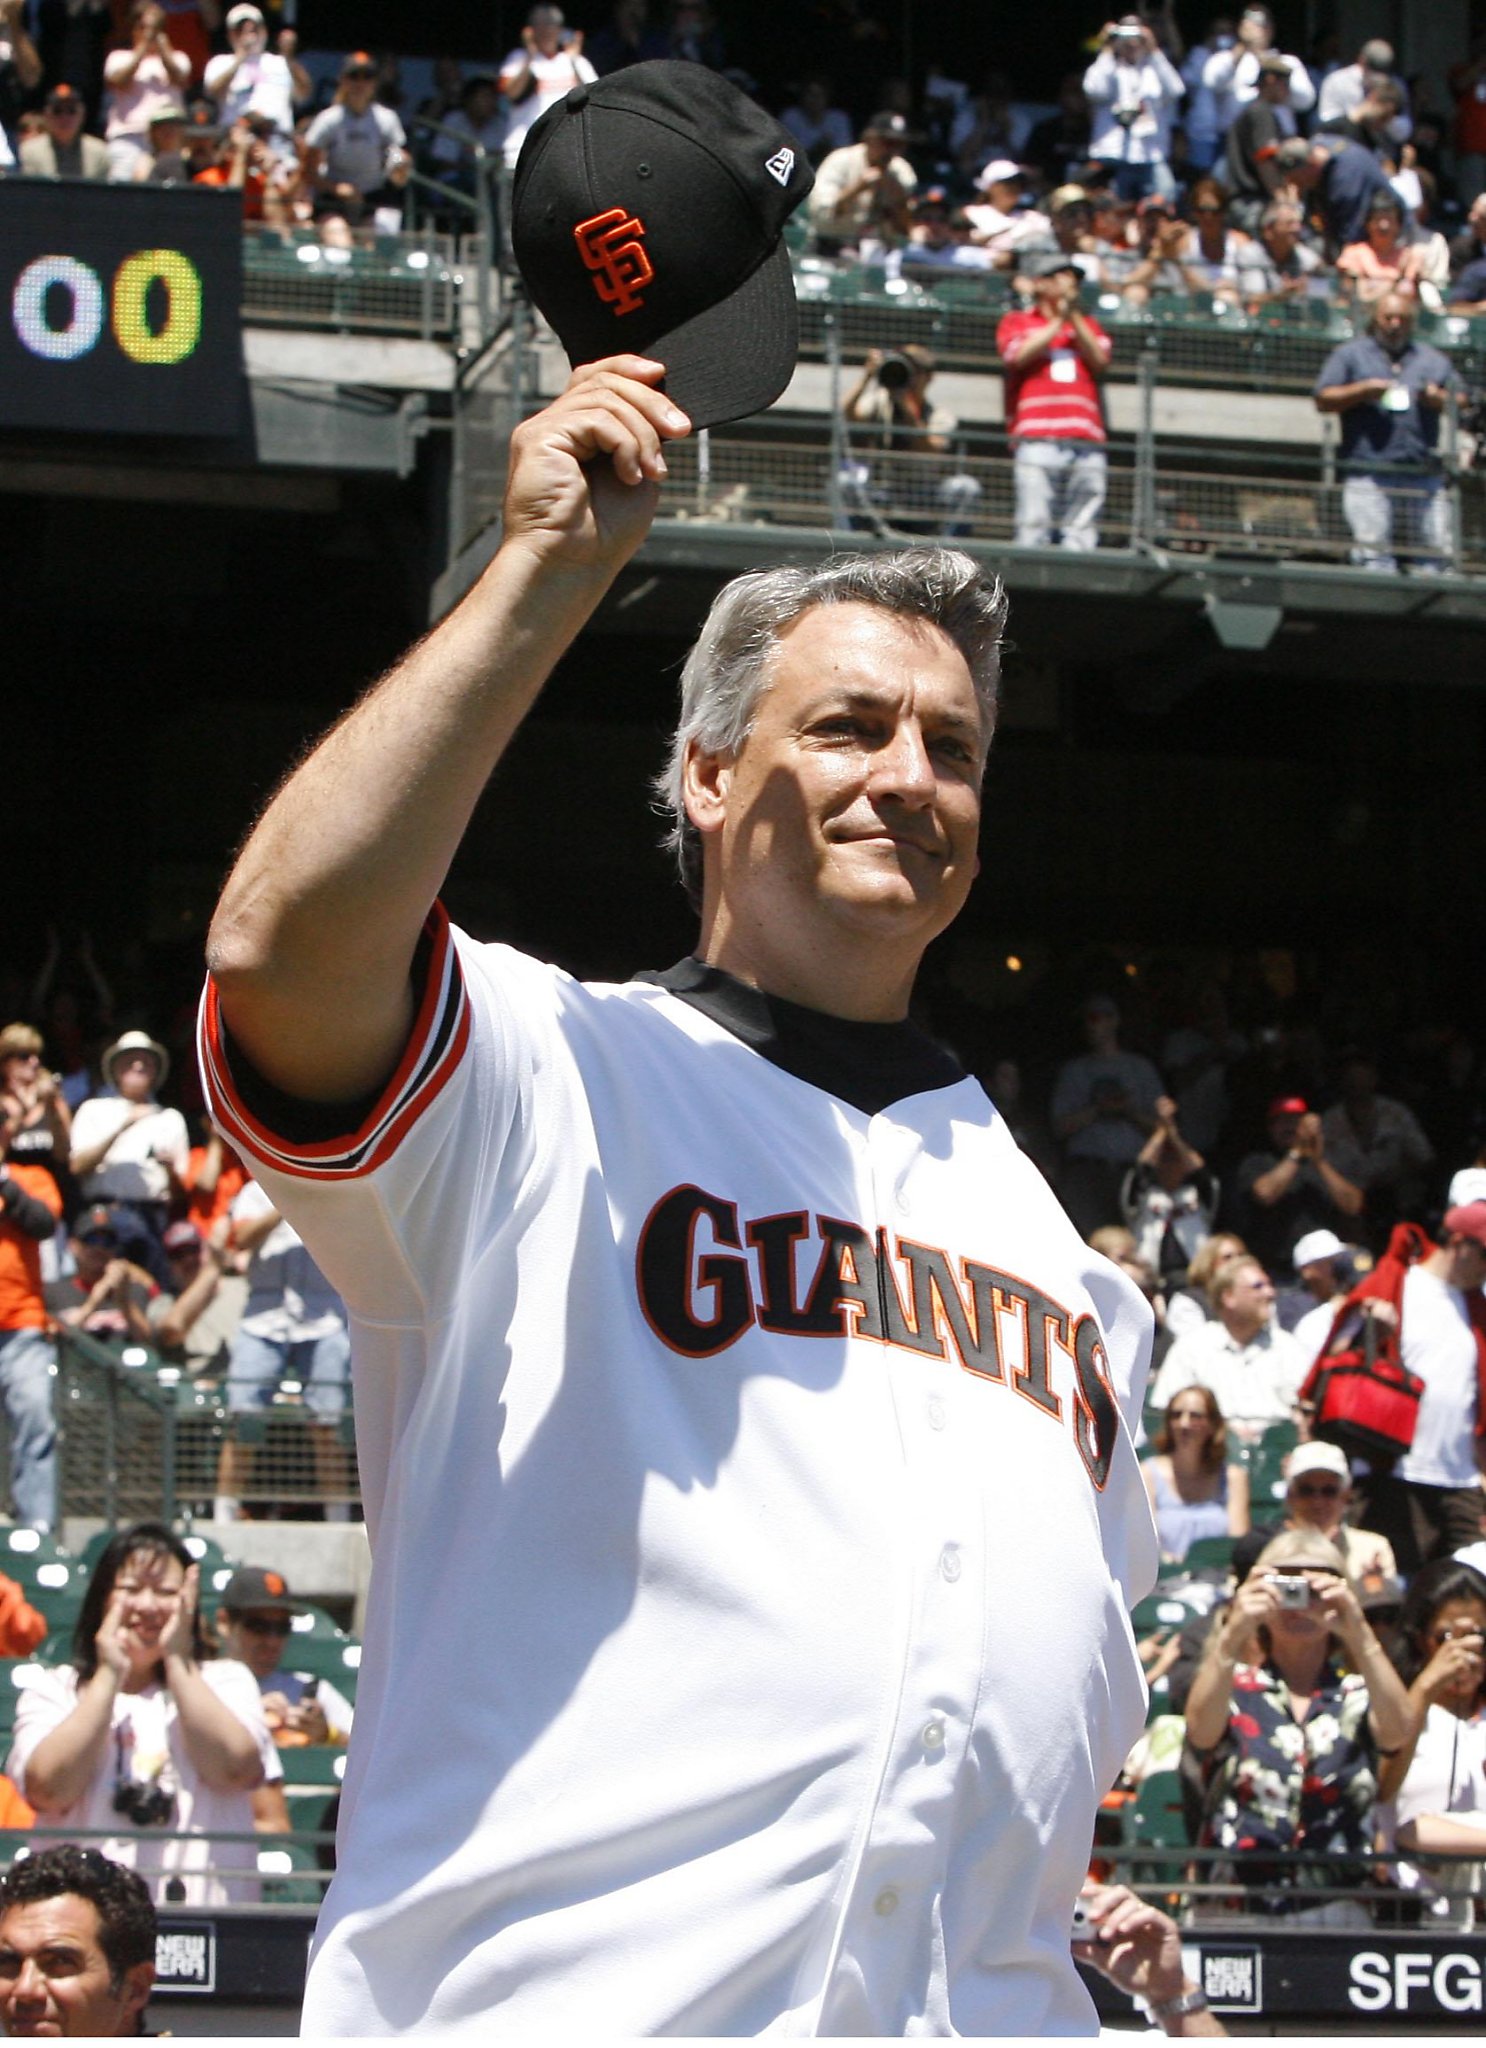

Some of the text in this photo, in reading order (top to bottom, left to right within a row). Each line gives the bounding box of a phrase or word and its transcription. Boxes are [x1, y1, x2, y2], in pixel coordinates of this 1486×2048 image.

[574, 206, 654, 317] SF
[635, 1182, 1120, 1494] GIANTS
[155, 1934, 206, 1955] NEW
[1204, 1956, 1252, 1976] NEW
